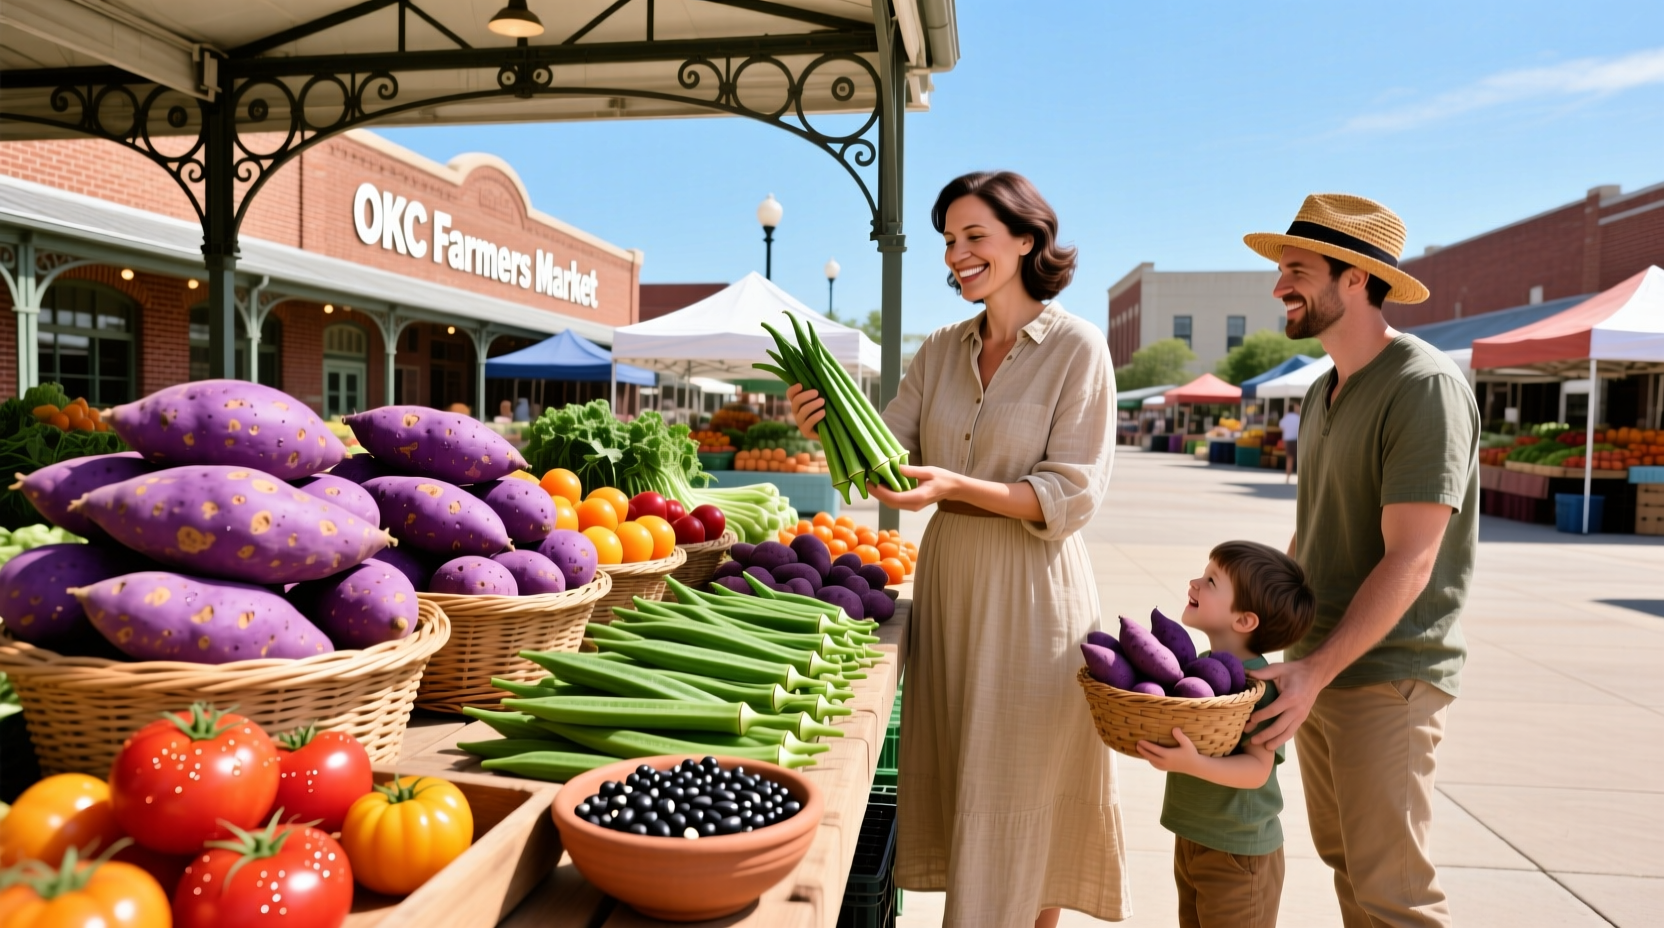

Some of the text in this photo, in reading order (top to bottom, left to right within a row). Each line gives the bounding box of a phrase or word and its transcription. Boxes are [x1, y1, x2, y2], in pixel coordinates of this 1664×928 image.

[353, 182, 599, 309] OKC Farmers Market
